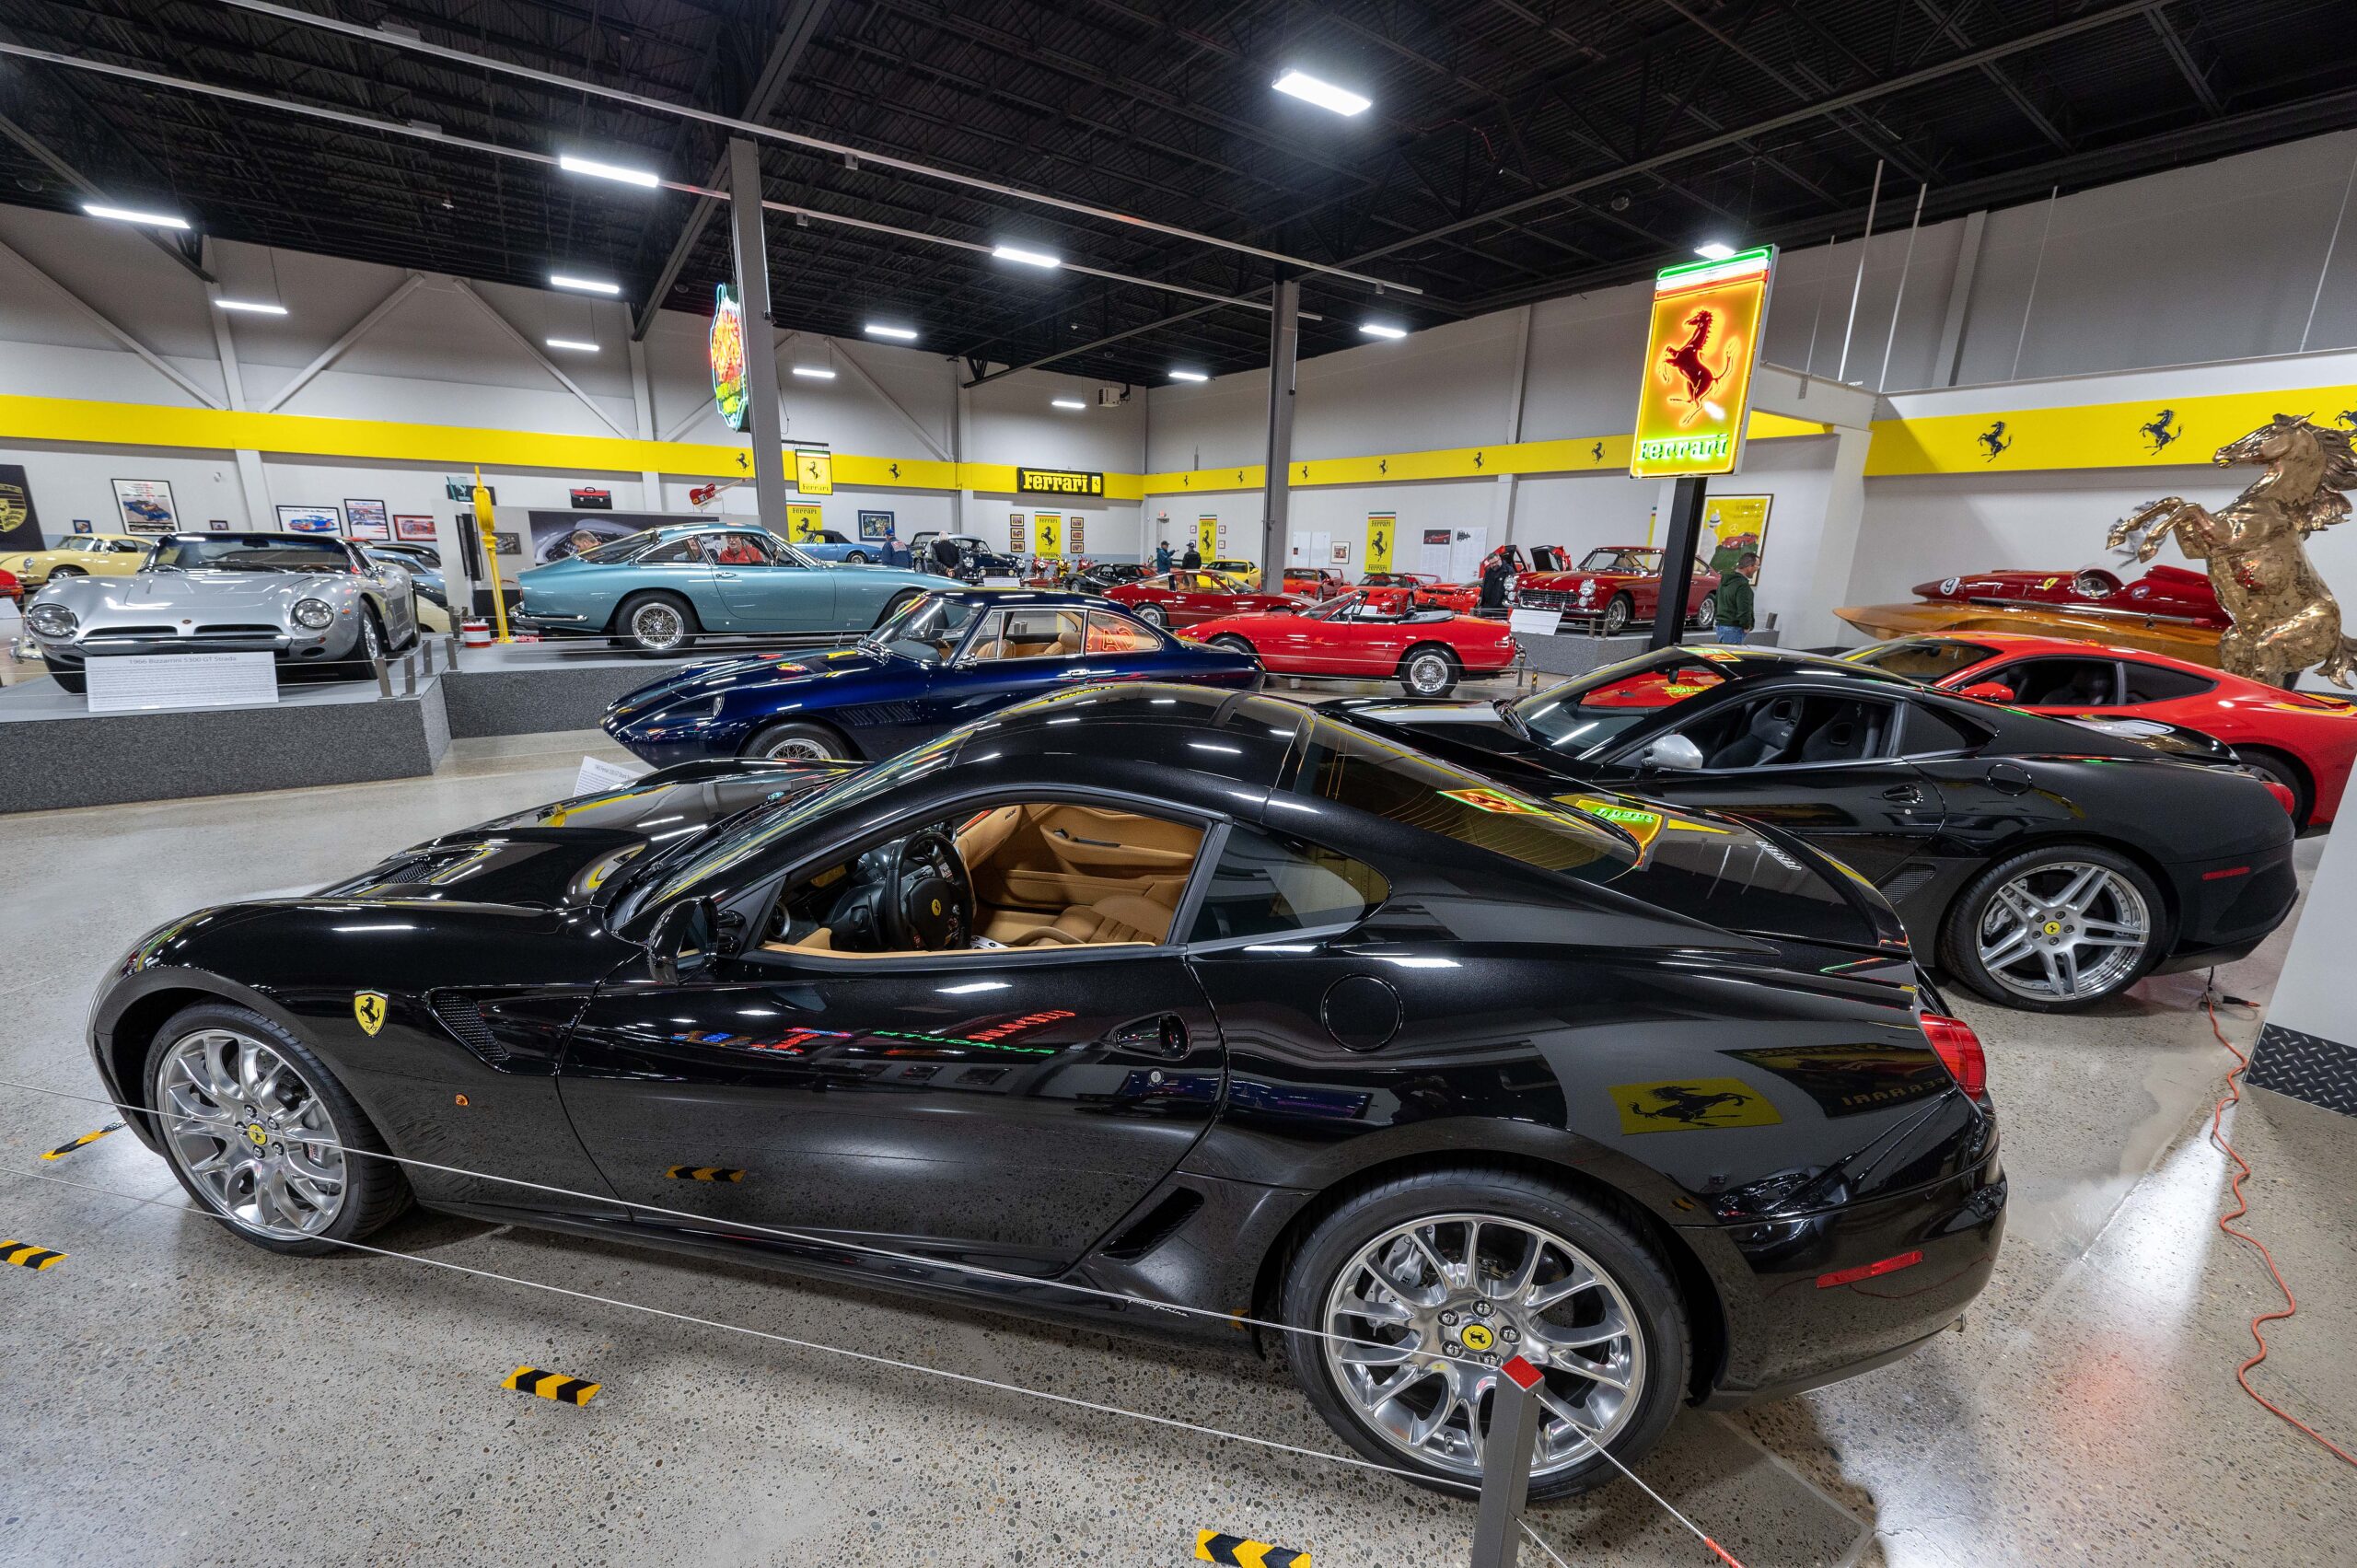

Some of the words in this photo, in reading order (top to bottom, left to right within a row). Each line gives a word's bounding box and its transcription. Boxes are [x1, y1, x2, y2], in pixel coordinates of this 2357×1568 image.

[1636, 434, 1728, 461] Ferrari
[802, 483, 830, 492] Ferrari
[1023, 470, 1088, 493] Ferrari
